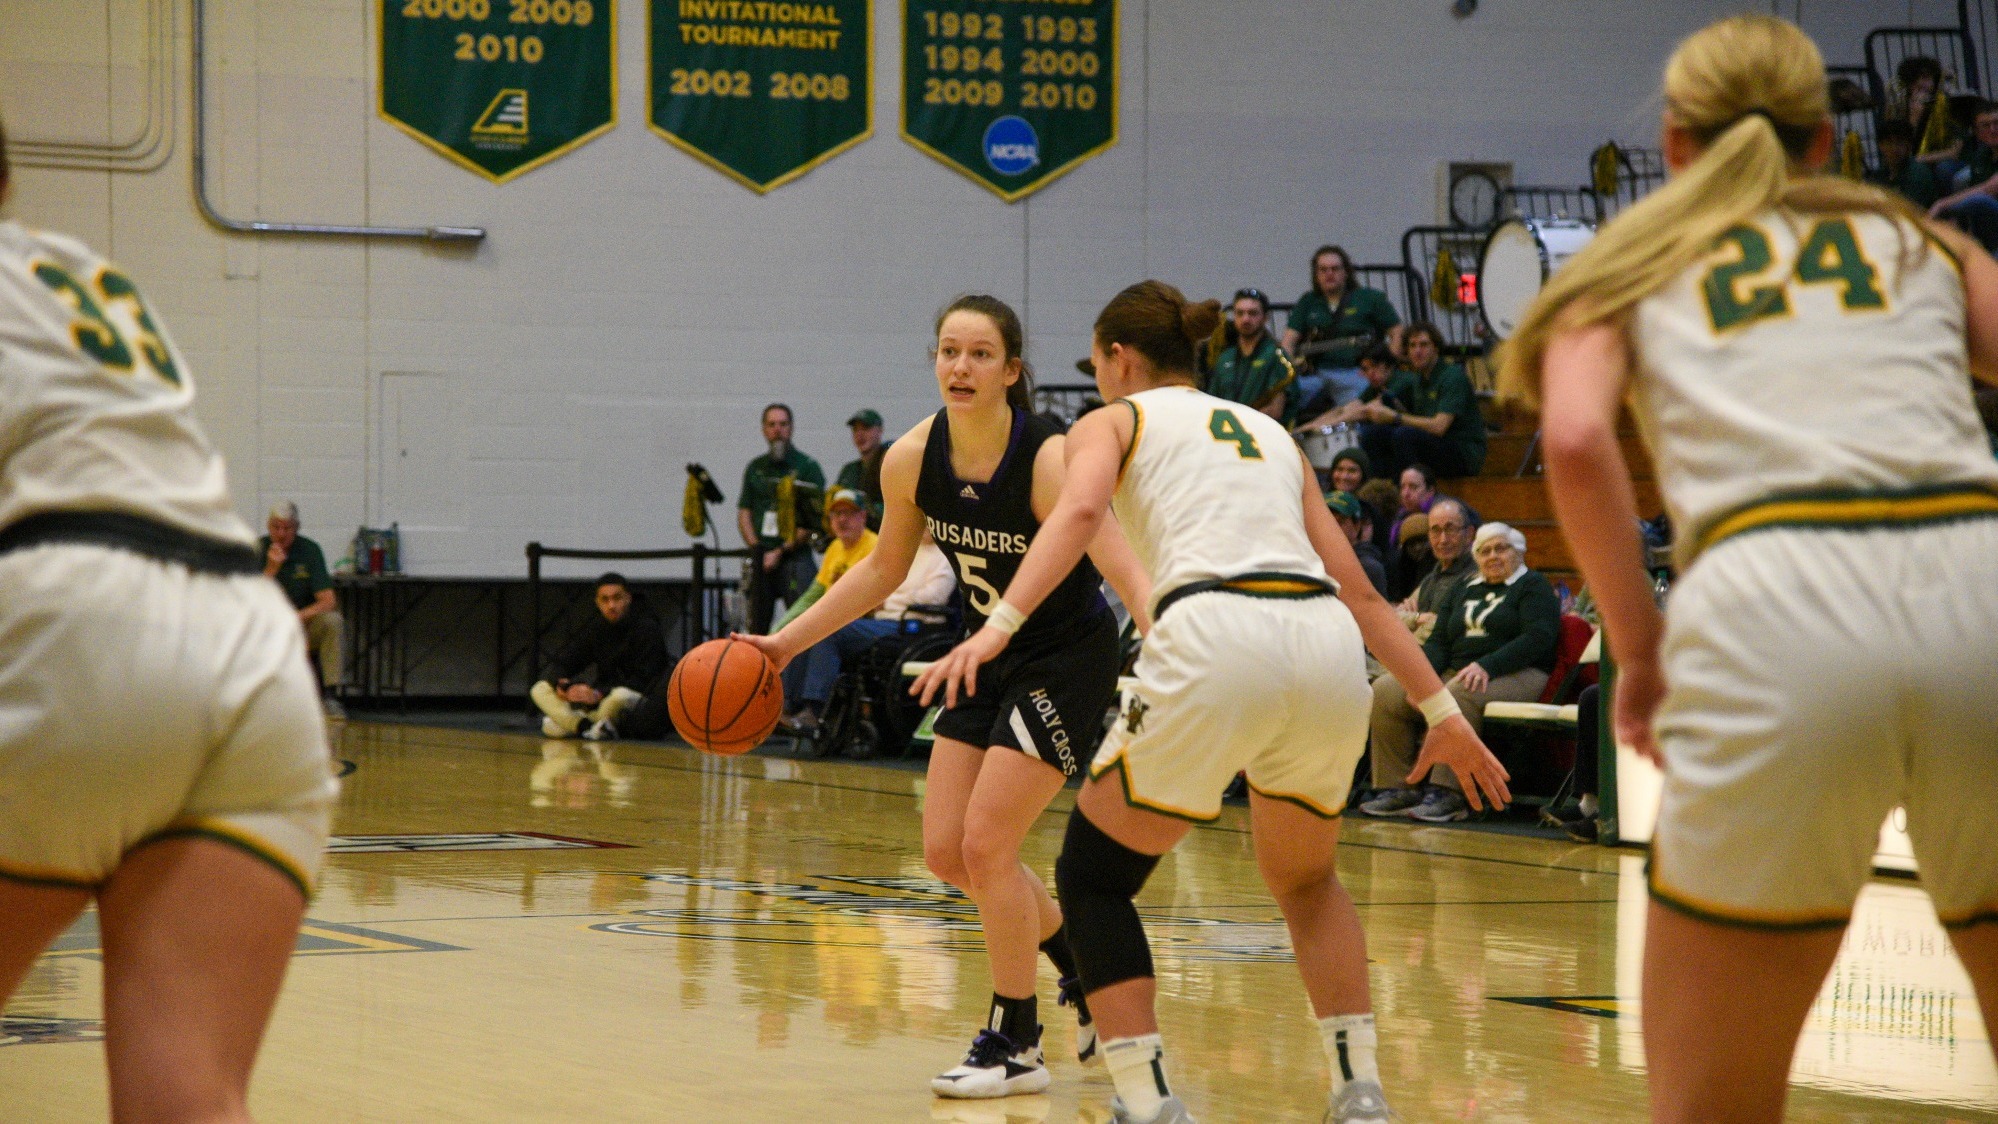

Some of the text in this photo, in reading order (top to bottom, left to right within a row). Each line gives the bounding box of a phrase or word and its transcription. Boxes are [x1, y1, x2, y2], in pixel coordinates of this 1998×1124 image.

[402, 0, 594, 26] 2000 2009
[678, 0, 841, 25] INVITATIONAL
[924, 11, 1098, 43] 1992 1993
[454, 33, 543, 63] 2010
[678, 23, 841, 50] TOURNAMENT
[924, 45, 1099, 77] 1994 2000
[670, 68, 850, 100] 2002 2008
[924, 78, 1097, 110] 2009 2010
[1698, 215, 1889, 337] 24
[31, 260, 184, 391] 33
[1207, 407, 1265, 462] 4
[925, 515, 1028, 554] RUSADERS
[954, 552, 1000, 617] 5
[1029, 687, 1063, 728] HOLY
